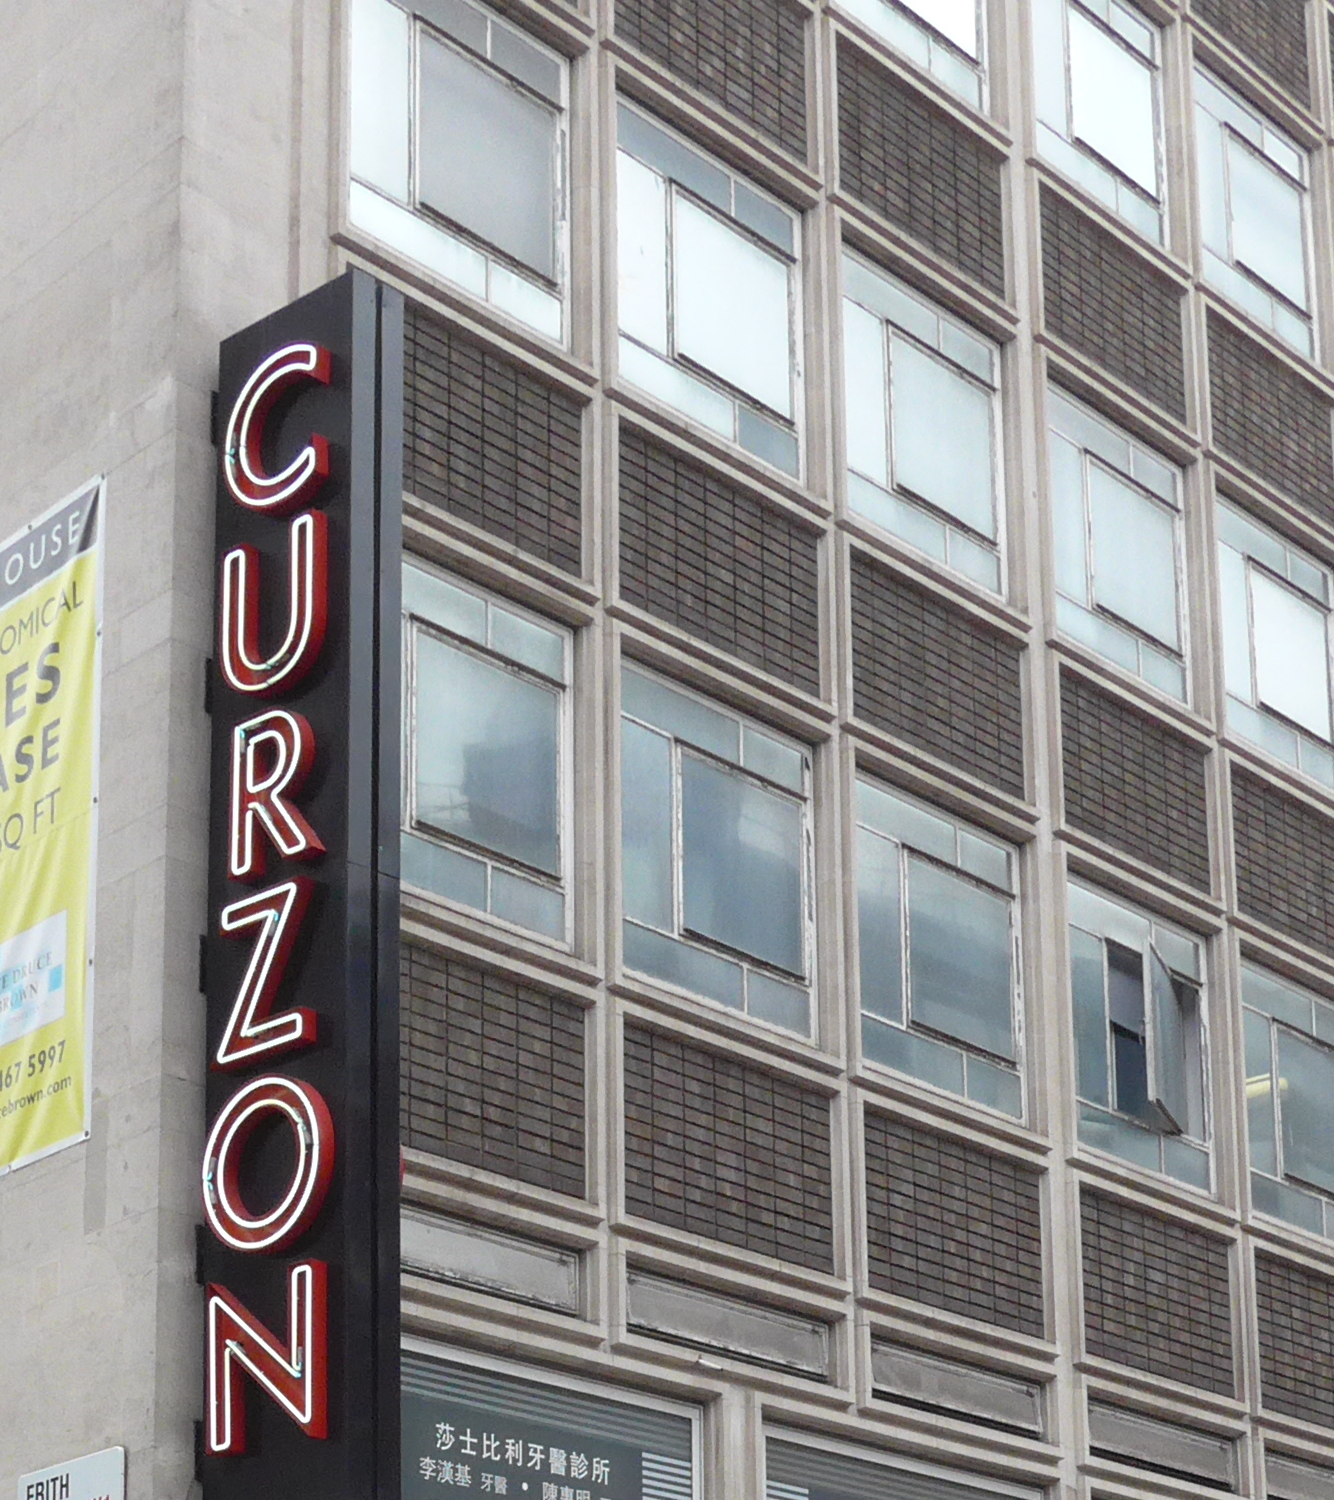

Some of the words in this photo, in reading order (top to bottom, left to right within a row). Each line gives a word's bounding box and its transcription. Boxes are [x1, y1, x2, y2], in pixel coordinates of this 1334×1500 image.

[33, 787, 61, 834] FT
[201, 342, 333, 1456] CURZON
[13, 951, 52, 983] DRUCE
[27, 1040, 66, 1078] 5997
[435, 1421, 611, 1485] 莎士比利牙醫診所
